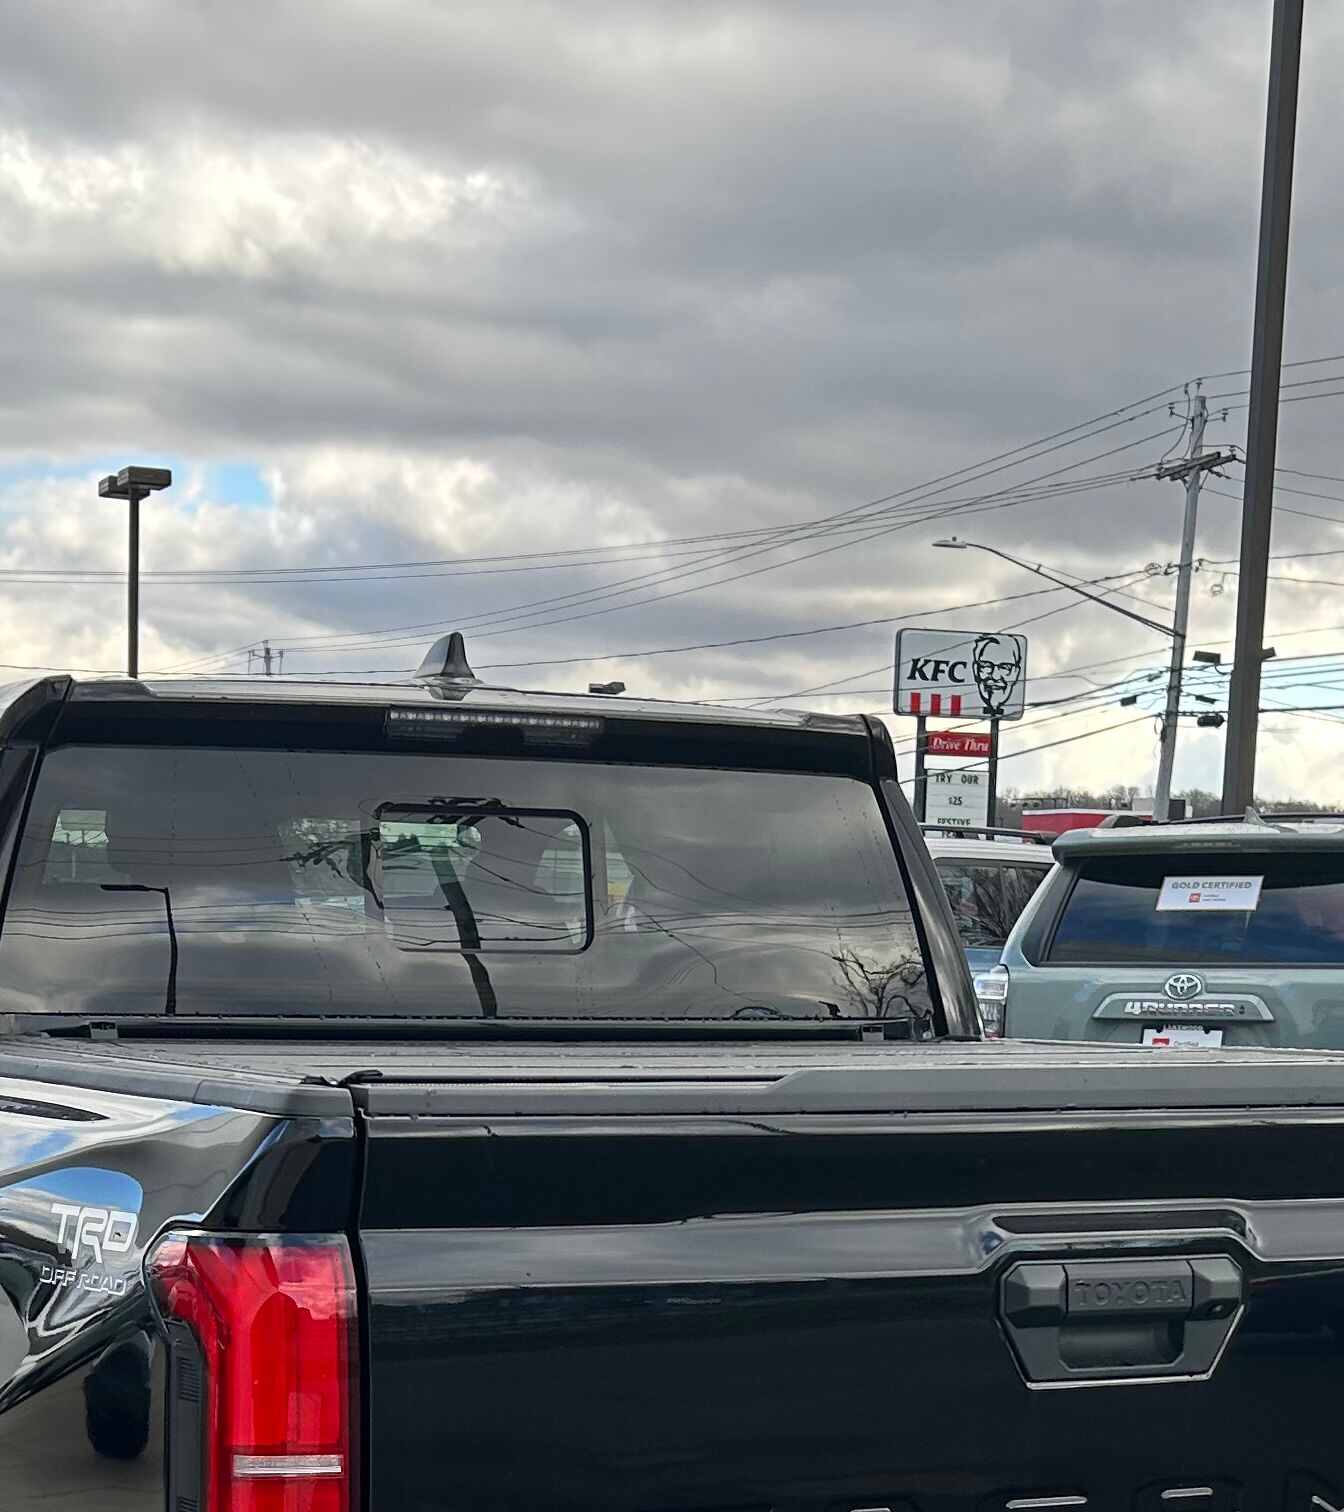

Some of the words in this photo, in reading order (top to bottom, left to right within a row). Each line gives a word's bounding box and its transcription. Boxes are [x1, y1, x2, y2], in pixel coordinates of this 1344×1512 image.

[907, 658, 967, 683] KFC
[932, 737, 961, 751] Drive
[964, 738, 989, 752] Thru
[936, 774, 953, 784] TRY
[961, 774, 979, 785] OUR
[948, 796, 963, 806] $25
[1171, 881, 1200, 889] GOLD
[1201, 881, 1253, 889] CERTIFIED
[51, 1203, 138, 1264] TRD
[40, 1265, 77, 1286] OFF
[77, 1273, 127, 1296] ROAD
[1074, 1279, 1186, 1306] TOYOTA
